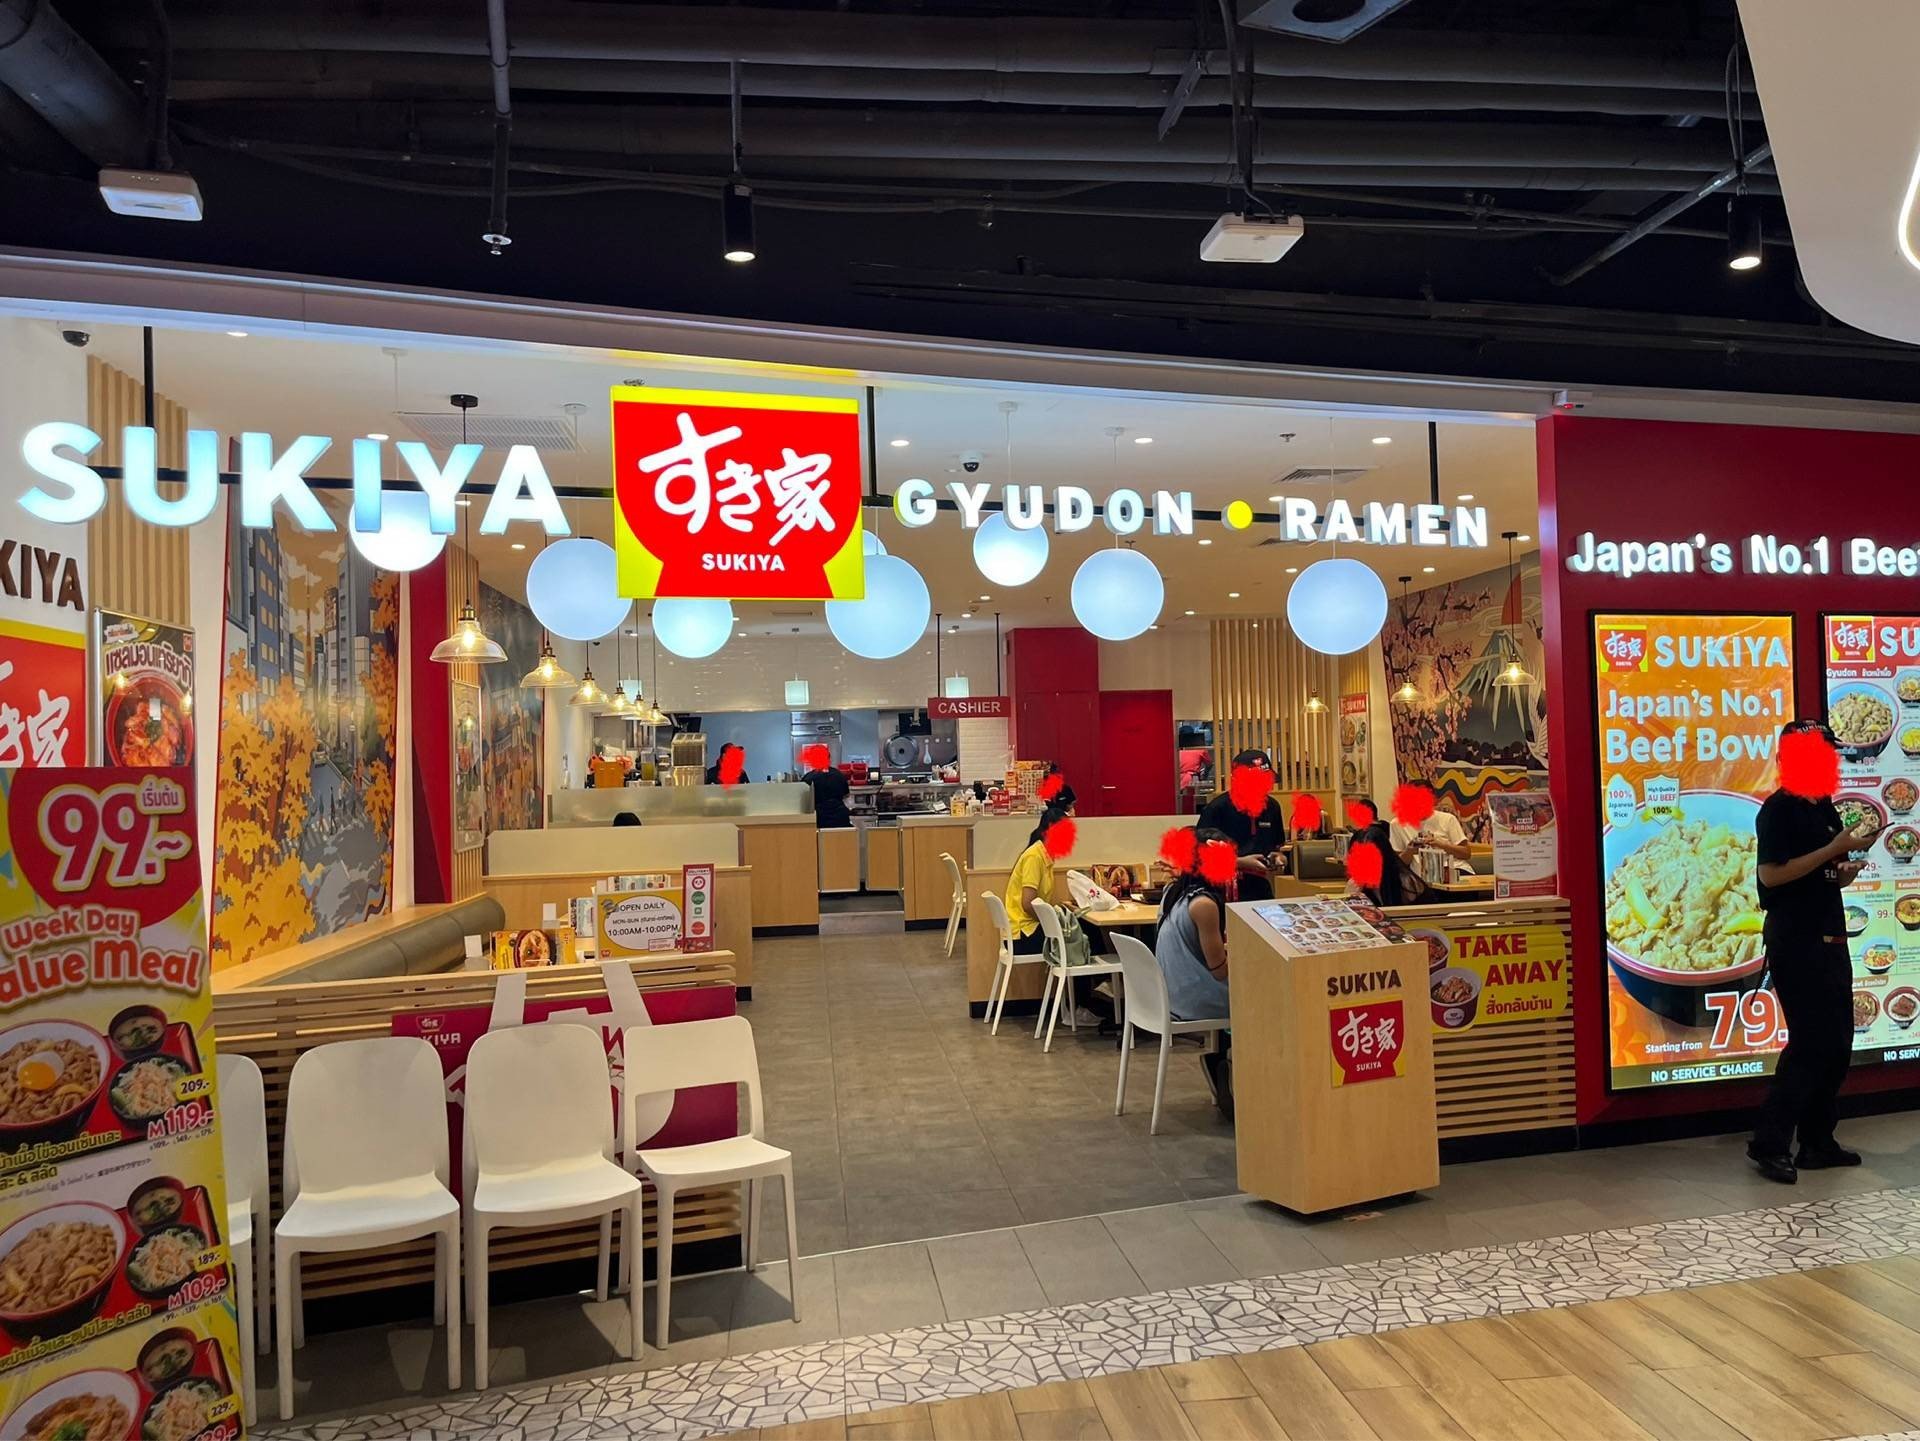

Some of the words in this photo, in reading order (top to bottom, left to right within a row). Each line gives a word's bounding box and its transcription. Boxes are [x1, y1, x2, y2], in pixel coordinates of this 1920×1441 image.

[17, 420, 571, 536] SUKIYA
[637, 411, 836, 547] すき家
[893, 478, 1194, 535] GYUDON
[1280, 497, 1489, 548] RAMEN
[701, 553, 785, 571] SUKIYA
[1567, 531, 1733, 578] Japan's
[1744, 534, 1830, 575] No.1
[1847, 537, 1920, 577] Bee
[1654, 635, 1789, 668] SUKIYA
[1826, 667, 1857, 679] Gyudon
[938, 701, 1001, 714] CASHIER
[1605, 688, 1713, 725] Japan's
[1721, 688, 1783, 717] No.1
[1605, 726, 1688, 764] Beef
[1609, 790, 1632, 799] 100%
[1660, 793, 1676, 801] BEEF
[1652, 806, 1673, 814] 100%
[620, 904, 641, 912] OPEN
[643, 902, 666, 910] DAILY
[4, 910, 81, 950] Week
[86, 908, 136, 939] Day
[1454, 932, 1528, 959] TAKE
[1327, 968, 1402, 997] SUKIYA
[1485, 958, 1564, 988] AWAY
[1337, 1010, 1397, 1058] すき家
[1645, 1042, 1681, 1054] Starting
[1681, 1040, 1703, 1051] from
[1883, 1050, 1897, 1062] NO
[1356, 1061, 1382, 1072] SUKIYA
[1651, 1070, 1668, 1083] NO
[1671, 1066, 1716, 1081] SERVICE
[1719, 1061, 1764, 1075] CHARGE
[17, 1171, 28, 1186] &
